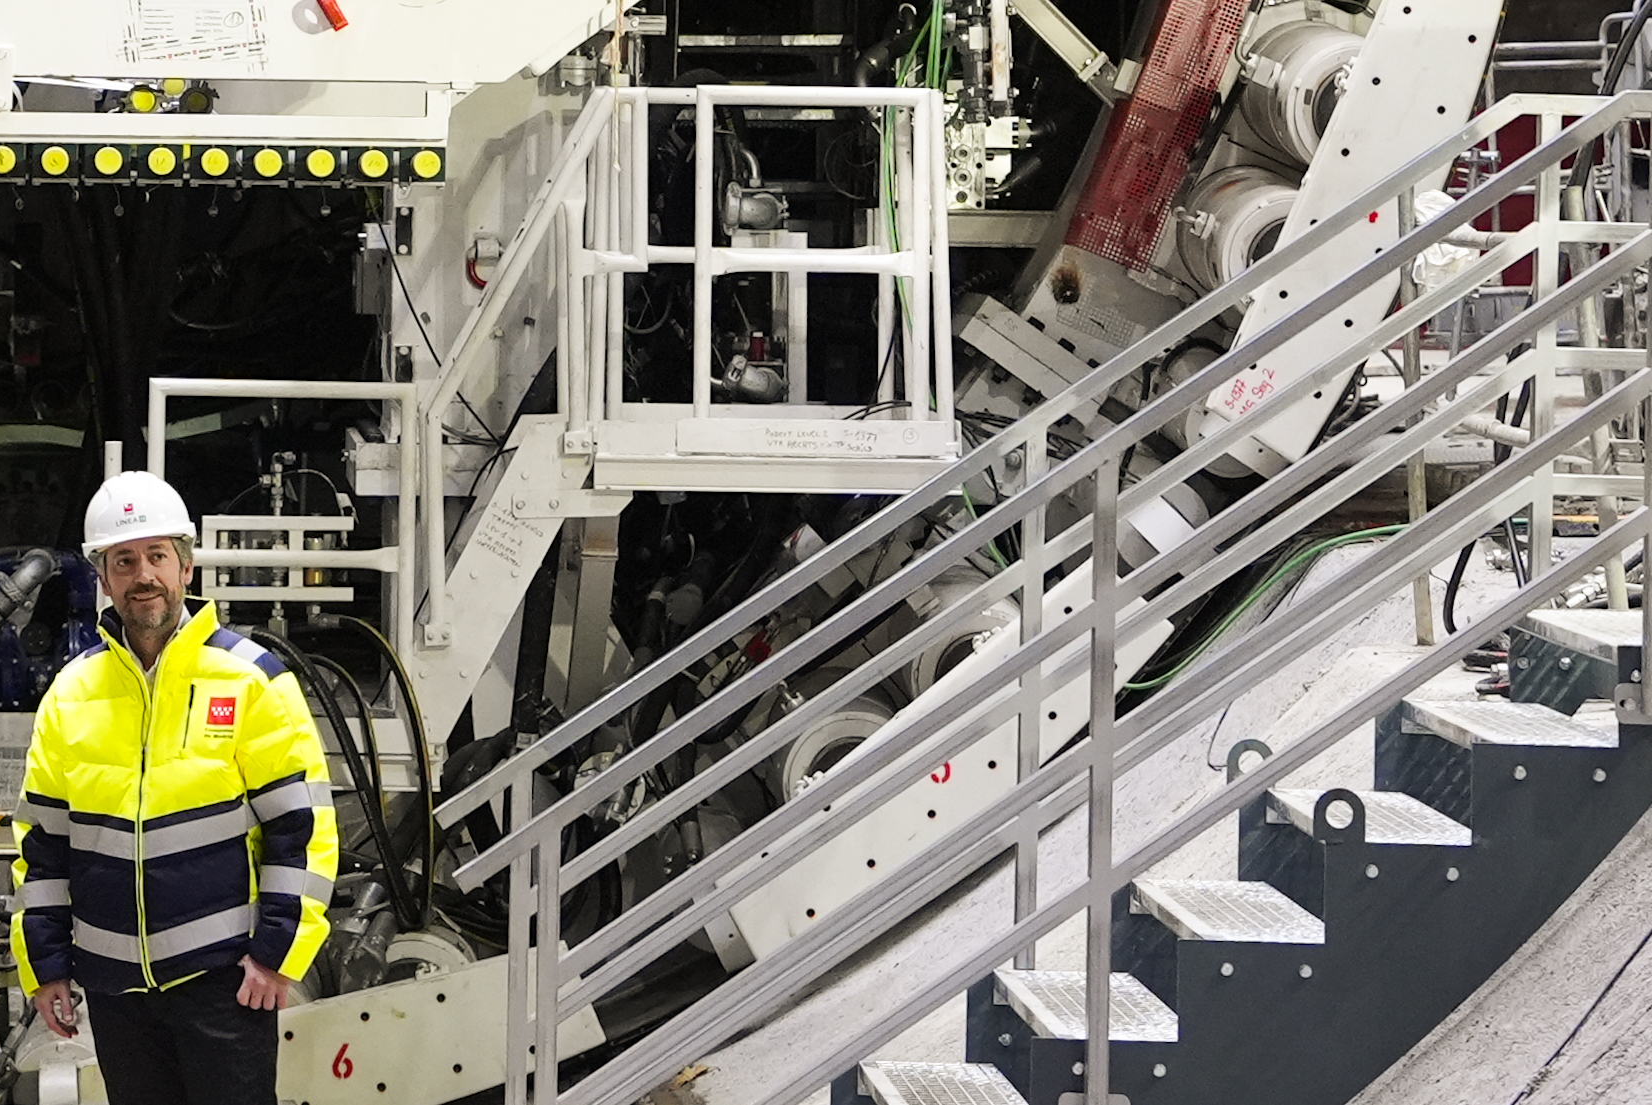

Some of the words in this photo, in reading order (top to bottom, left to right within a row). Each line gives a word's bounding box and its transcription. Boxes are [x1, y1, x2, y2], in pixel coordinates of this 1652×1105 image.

[1262, 368, 1275, 380] 2
[1225, 379, 1247, 410] S-1377
[115, 517, 138, 527] LINEA
[332, 1043, 355, 1080] 6
